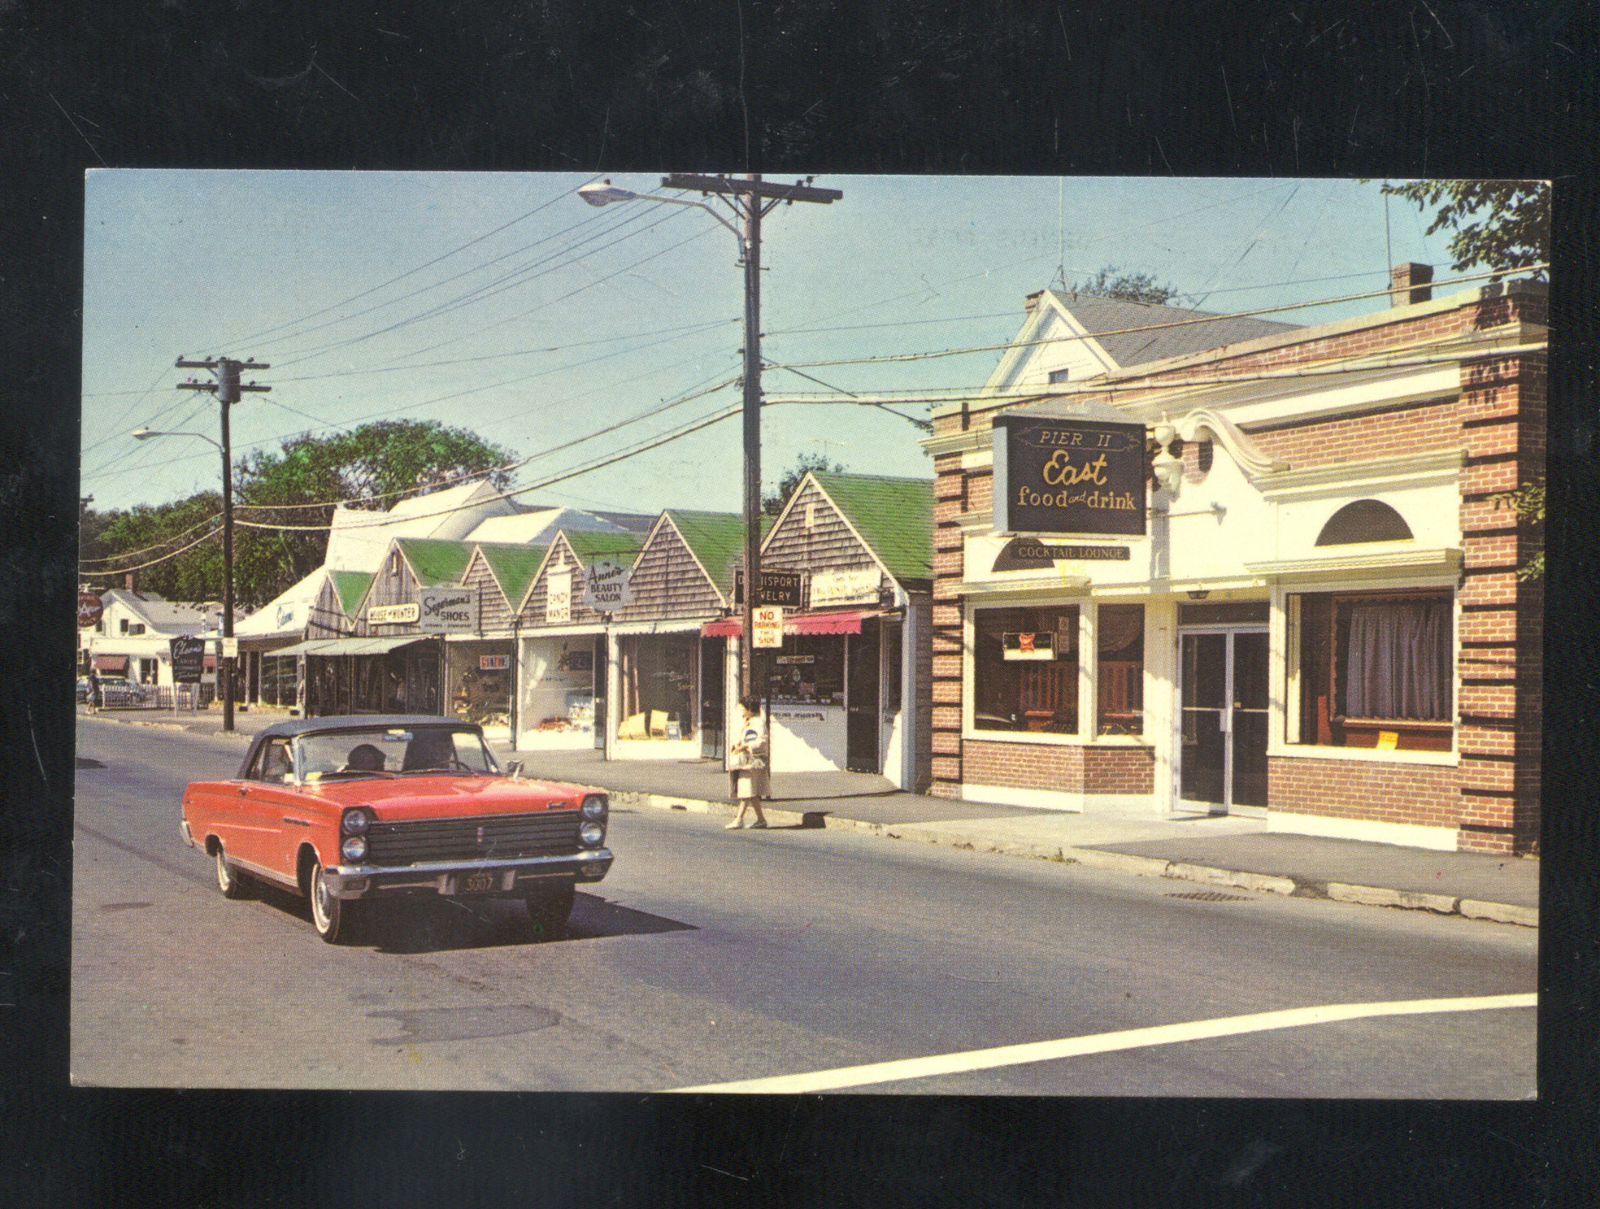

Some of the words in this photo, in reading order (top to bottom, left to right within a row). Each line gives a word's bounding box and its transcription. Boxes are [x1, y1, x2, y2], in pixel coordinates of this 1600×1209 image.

[1040, 431, 1082, 446] PIER
[1097, 434, 1112, 447] II
[1043, 449, 1108, 486] East
[1017, 485, 1067, 508] food
[1068, 490, 1087, 504] and
[1087, 491, 1137, 510] drink
[1018, 546, 1076, 558] COCKTAIL
[1080, 547, 1125, 559] LOUNGE
[590, 582, 623, 593] BEAUTY
[594, 592, 622, 602] SALON
[440, 611, 470, 621] SHOES
[759, 611, 775, 621] NO
[754, 621, 780, 629] PARKING
[758, 637, 776, 645] SIDE
